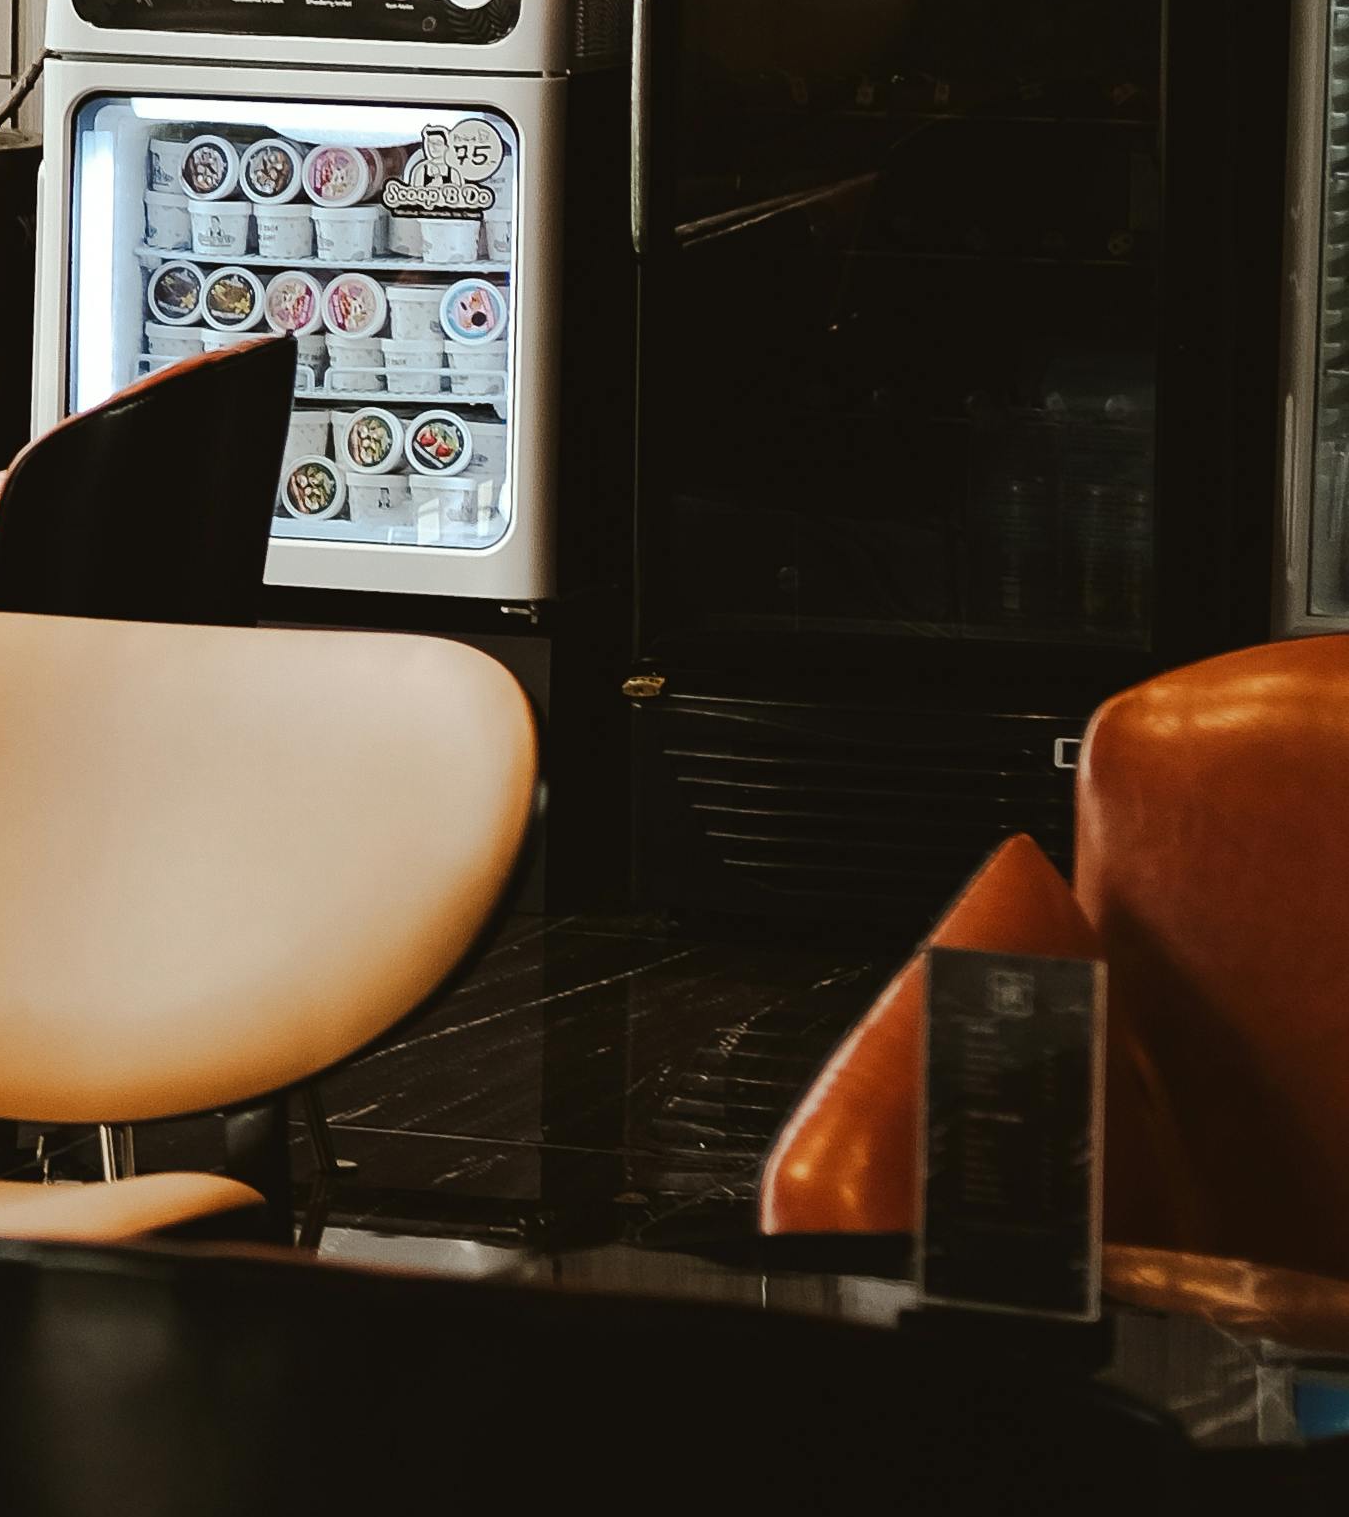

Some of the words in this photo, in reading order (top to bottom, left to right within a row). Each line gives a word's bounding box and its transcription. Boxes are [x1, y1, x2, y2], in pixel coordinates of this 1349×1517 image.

[384, 181, 439, 209] Scoop
[442, 185, 460, 205] B
[462, 185, 492, 205] Do
